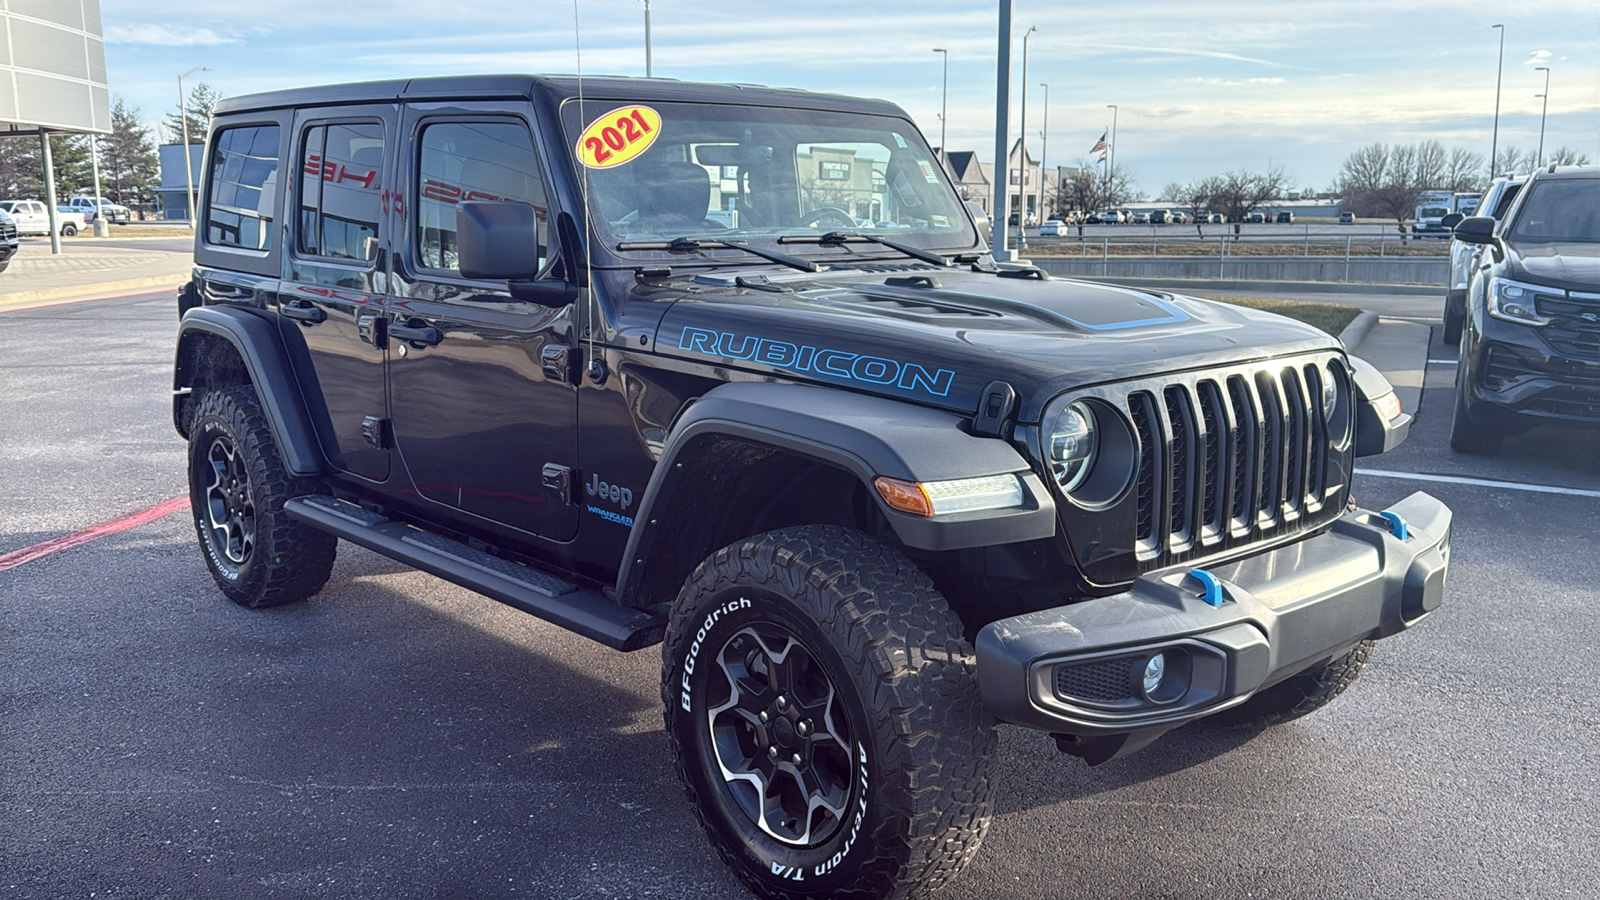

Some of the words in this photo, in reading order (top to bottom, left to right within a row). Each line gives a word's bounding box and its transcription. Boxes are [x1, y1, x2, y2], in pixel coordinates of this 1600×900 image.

[585, 109, 653, 165] 2021
[678, 326, 956, 397] RUBICON
[585, 473, 633, 510] Jeep
[586, 504, 633, 525] WRANGLER
[681, 596, 752, 712] BFGoodrich
[814, 740, 868, 877] All-Terrain
[771, 861, 805, 881] T/A
